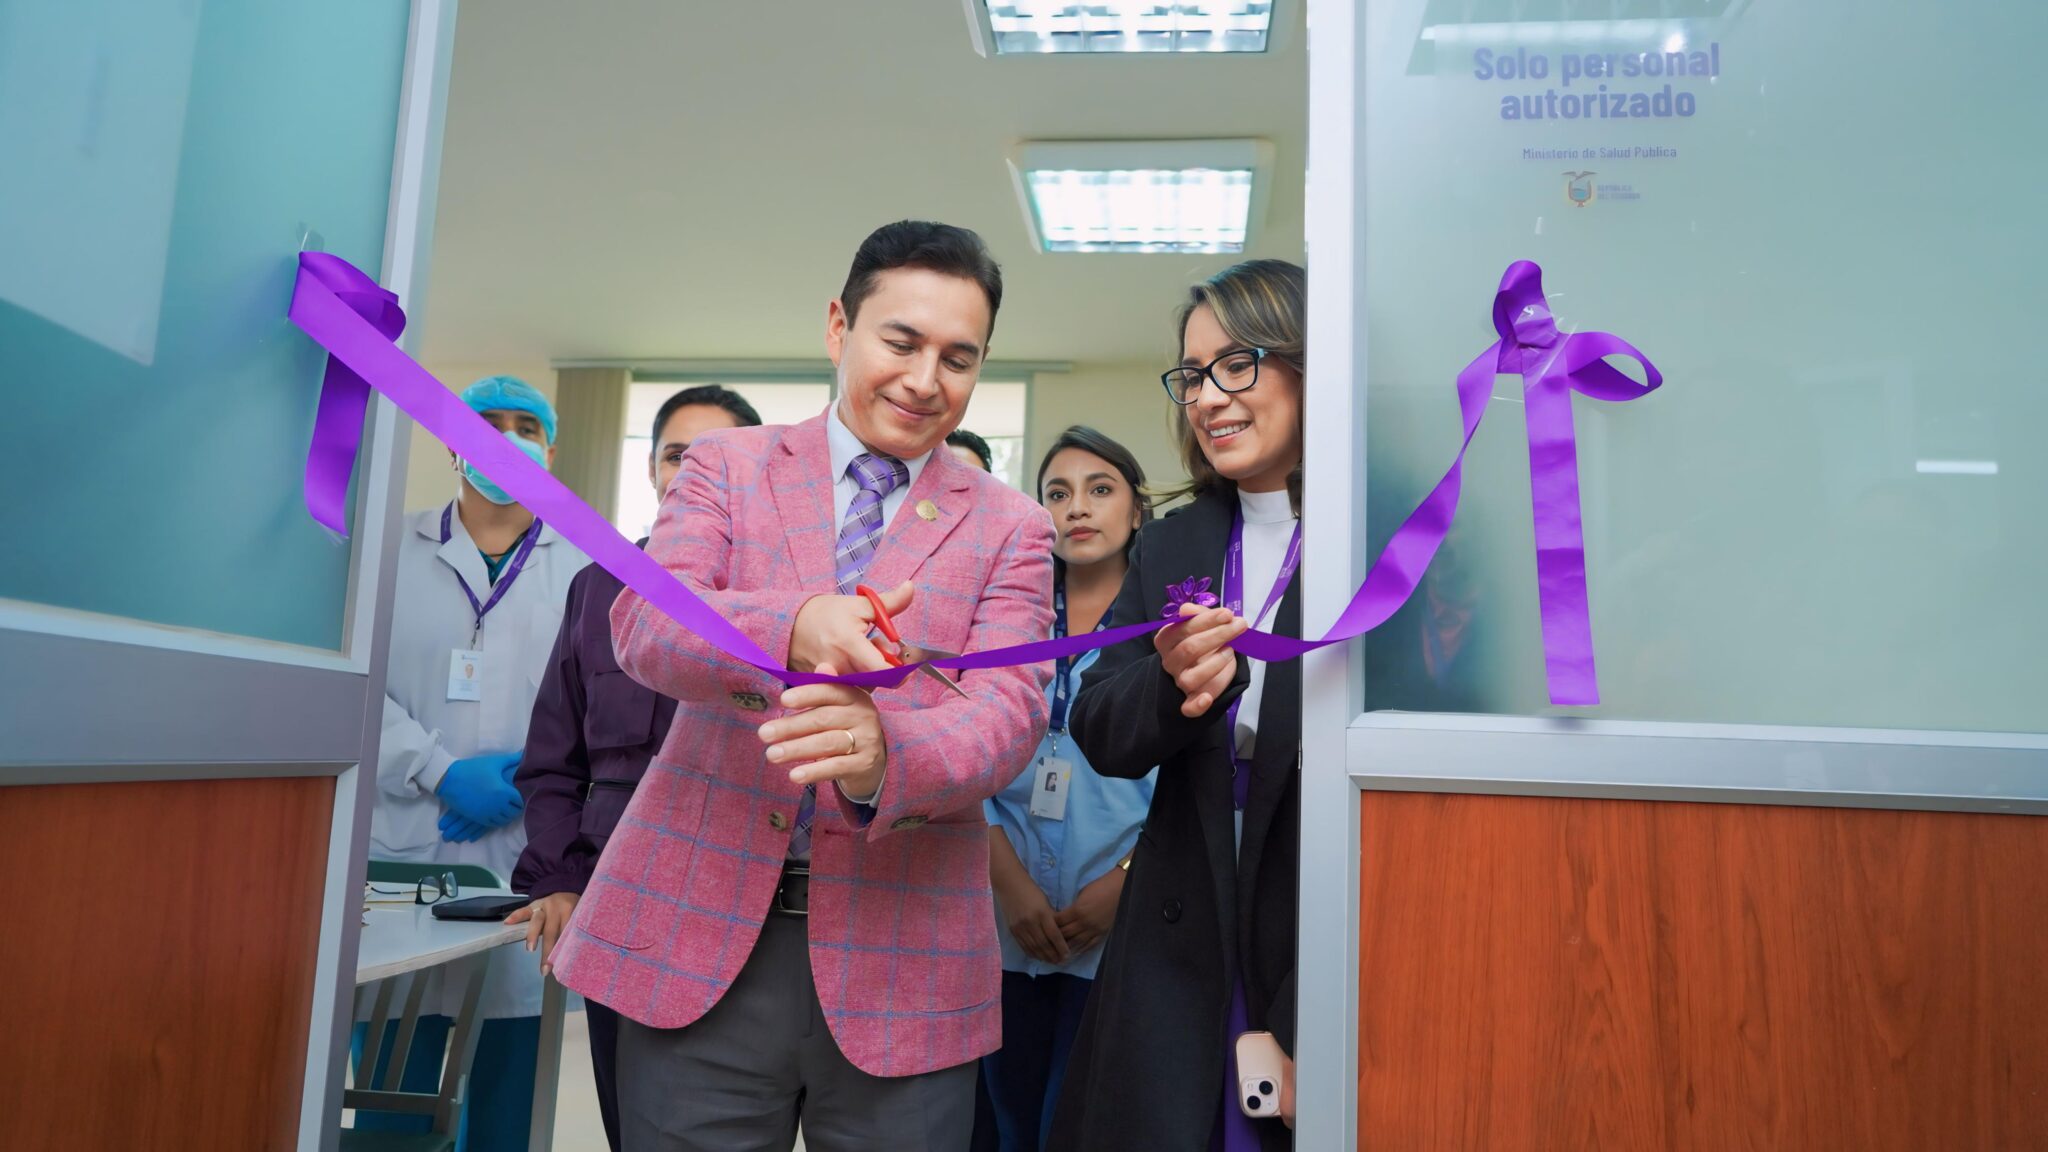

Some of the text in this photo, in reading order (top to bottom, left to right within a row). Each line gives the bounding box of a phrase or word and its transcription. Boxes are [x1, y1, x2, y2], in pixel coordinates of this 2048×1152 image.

[1473, 42, 1720, 86] Solo personal
[1500, 84, 1696, 120] autorizado
[1523, 148, 1578, 160] Ministerio
[1582, 148, 1596, 159] de
[1600, 147, 1631, 159] Salud
